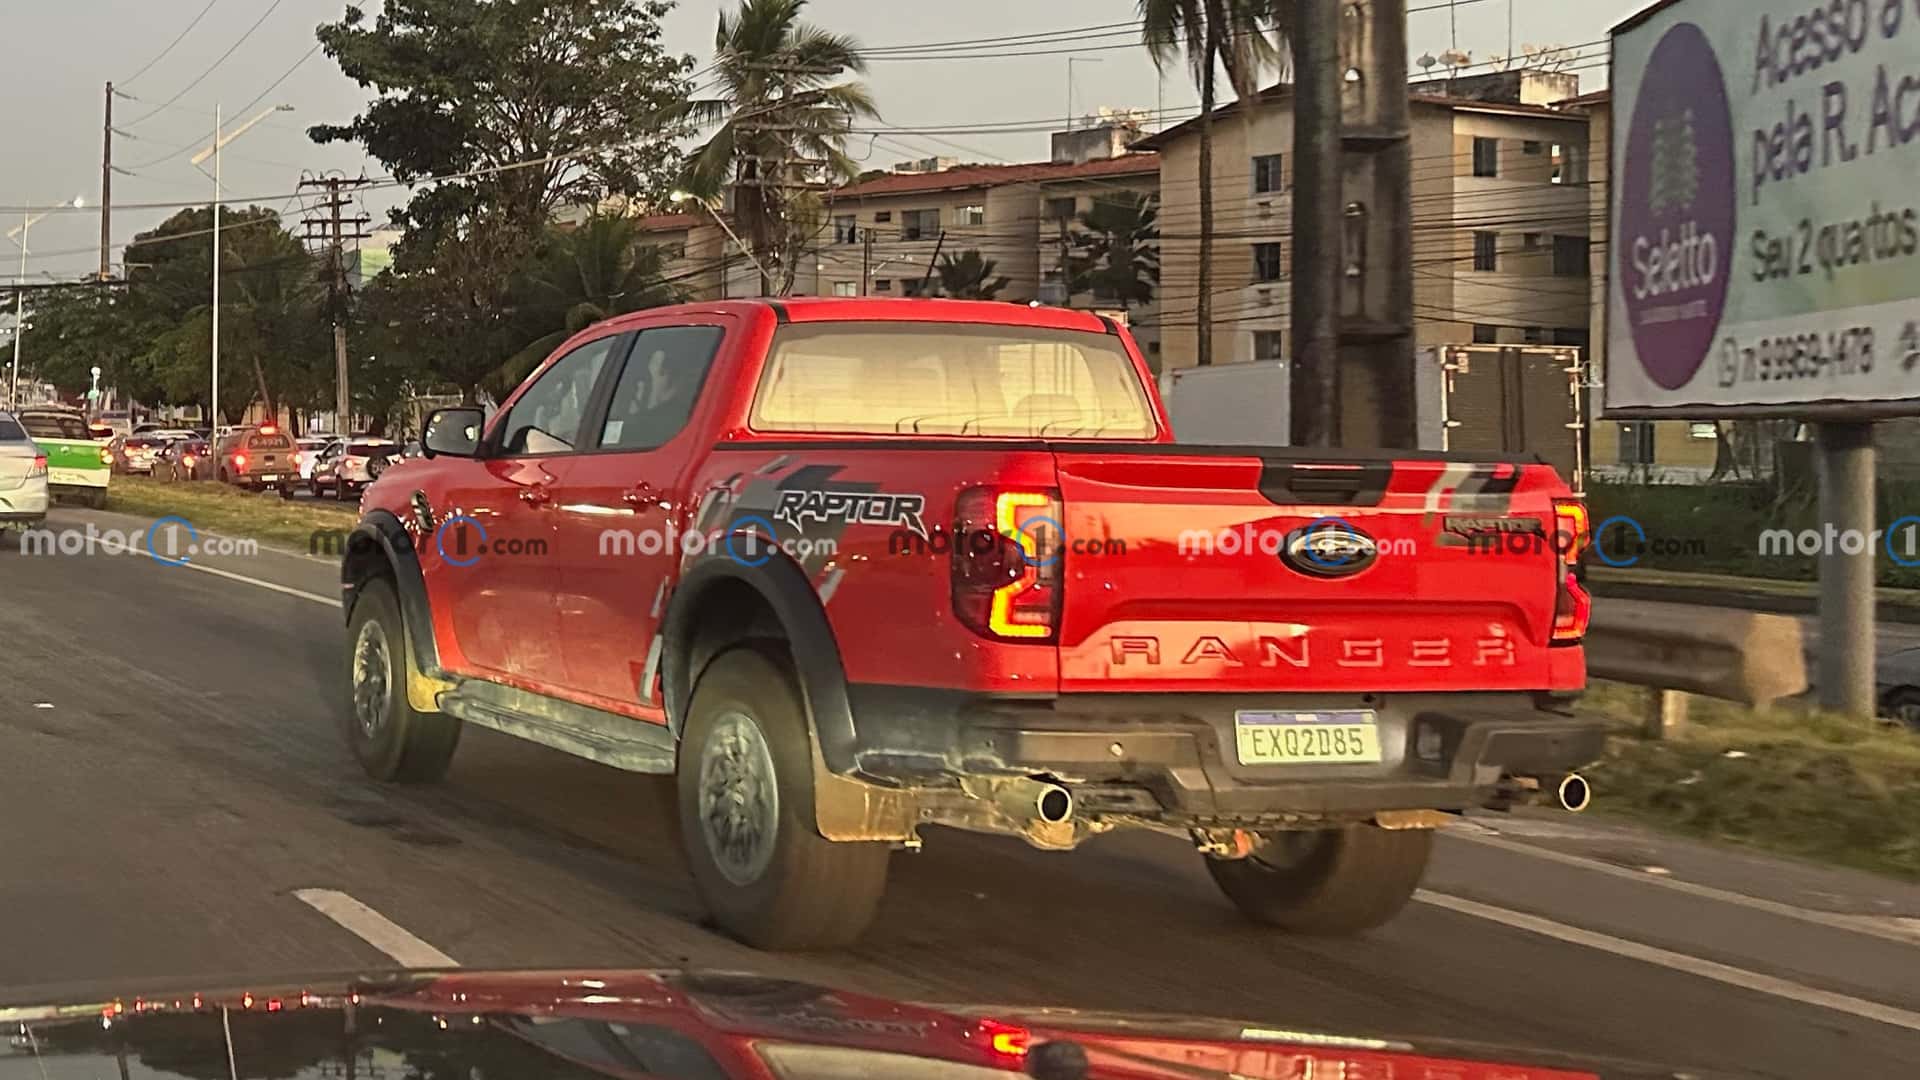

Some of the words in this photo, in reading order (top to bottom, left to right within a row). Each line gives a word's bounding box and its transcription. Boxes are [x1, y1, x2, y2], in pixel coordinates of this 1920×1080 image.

[1751, 0, 1868, 95] Acesso
[1752, 99, 1812, 205] pela
[1822, 80, 1858, 166] R.
[1631, 219, 1718, 299] Seletto
[1751, 228, 1791, 282] Seu
[1797, 218, 1812, 276] 2
[1817, 203, 1917, 280] quartos
[773, 489, 929, 541] RAPTOR
[1109, 634, 1517, 668] RANGER
[1252, 728, 1364, 757] EXQ2D85
